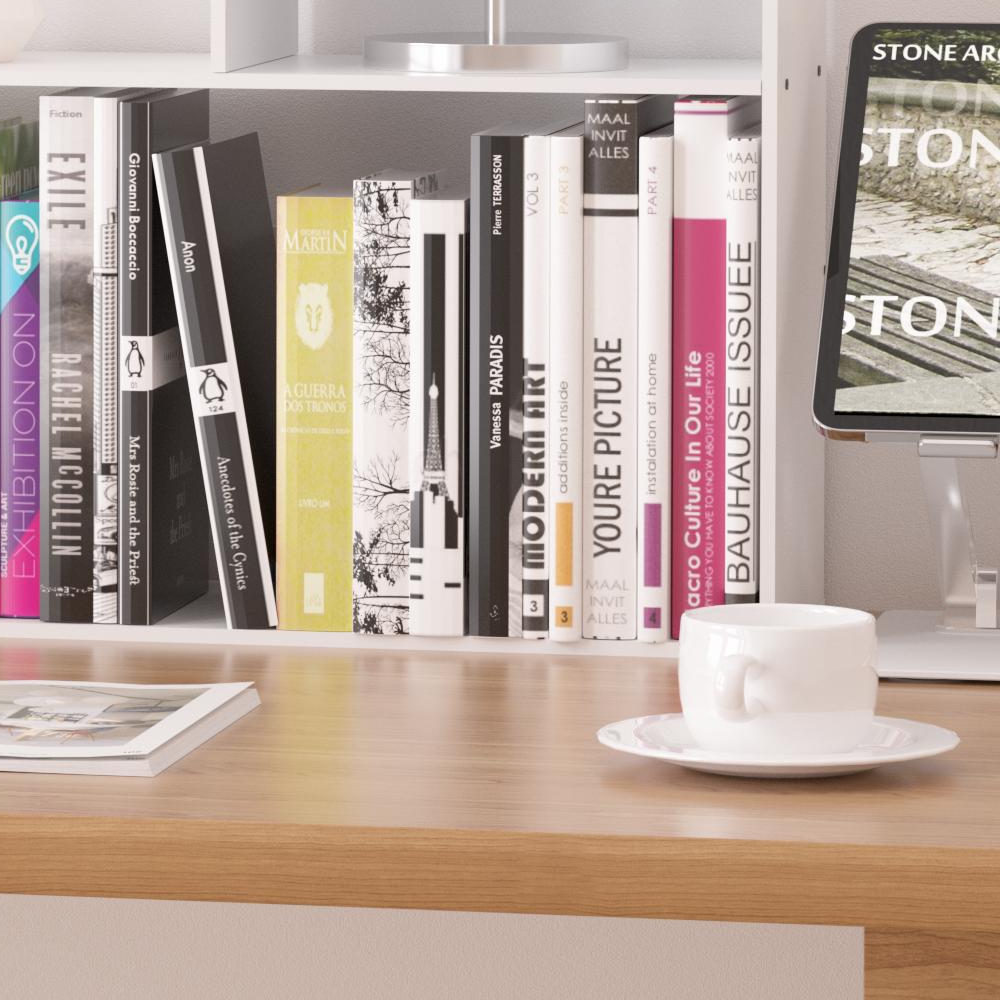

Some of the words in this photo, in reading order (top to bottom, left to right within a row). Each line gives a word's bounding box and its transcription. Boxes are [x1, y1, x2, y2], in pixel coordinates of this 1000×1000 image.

[872, 43, 958, 61] STONE
[962, 45, 1000, 62] AR
[49, 110, 83, 118] Fiction
[587, 113, 631, 125] MAAL
[591, 130, 627, 142] INVIT
[588, 147, 630, 159] ALLES
[129, 152, 141, 212] Giovanni
[493, 154, 502, 207] TERRASSON
[527, 172, 539, 182] 3
[648, 166, 657, 174] 4
[47, 153, 86, 230] EXILE
[527, 189, 539, 217] VOL
[648, 179, 657, 215] PART
[493, 210, 502, 235] Pierre
[129, 216, 141, 281] Boccaccio
[181, 240, 197, 273] Anon
[283, 230, 348, 251] MARTIN
[728, 242, 752, 371] ISSUEE
[13, 313, 36, 368] ON
[490, 334, 504, 396] PARADIS
[646, 353, 657, 396] home
[684, 351, 702, 387] Life
[705, 352, 715, 378] 2000
[52, 353, 83, 435] RACHEL
[523, 358, 545, 419] ART
[559, 380, 569, 423] inside
[593, 338, 622, 455] PICTURE
[705, 379, 715, 419] SOCIETY
[208, 405, 224, 413] 124
[646, 401, 657, 416] at
[684, 394, 702, 435] Our
[490, 402, 502, 449] Vanessa
[705, 420, 715, 456] ABOUT
[129, 436, 141, 466] Mrs
[558, 427, 569, 494] additions
[646, 419, 657, 495] instalation
[685, 441, 702, 462] In
[13, 381, 36, 579] EXHIBITION
[129, 467, 140, 498] Rosie
[217, 456, 236, 515] Anecdotes
[705, 459, 714, 493] KNOW
[727, 386, 751, 583] BAUHAUSE
[129, 499, 140, 524] and
[593, 464, 622, 558] YOURE
[684, 468, 701, 549] Culture
[705, 494, 714, 512] TO
[129, 525, 140, 544] the
[227, 516, 239, 529] of
[705, 512, 714, 541] HAVE
[229, 529, 244, 550] the
[705, 542, 714, 564] YOU
[129, 551, 141, 586] Priest
[231, 552, 248, 591] Cynics
[586, 579, 629, 591] MAAL
[688, 555, 701, 607] acro
[530, 601, 538, 613] 3
[561, 611, 569, 623] 3
[590, 596, 626, 607] INVIT
[649, 612, 657, 624] 4
[586, 613, 628, 625] ALLES
